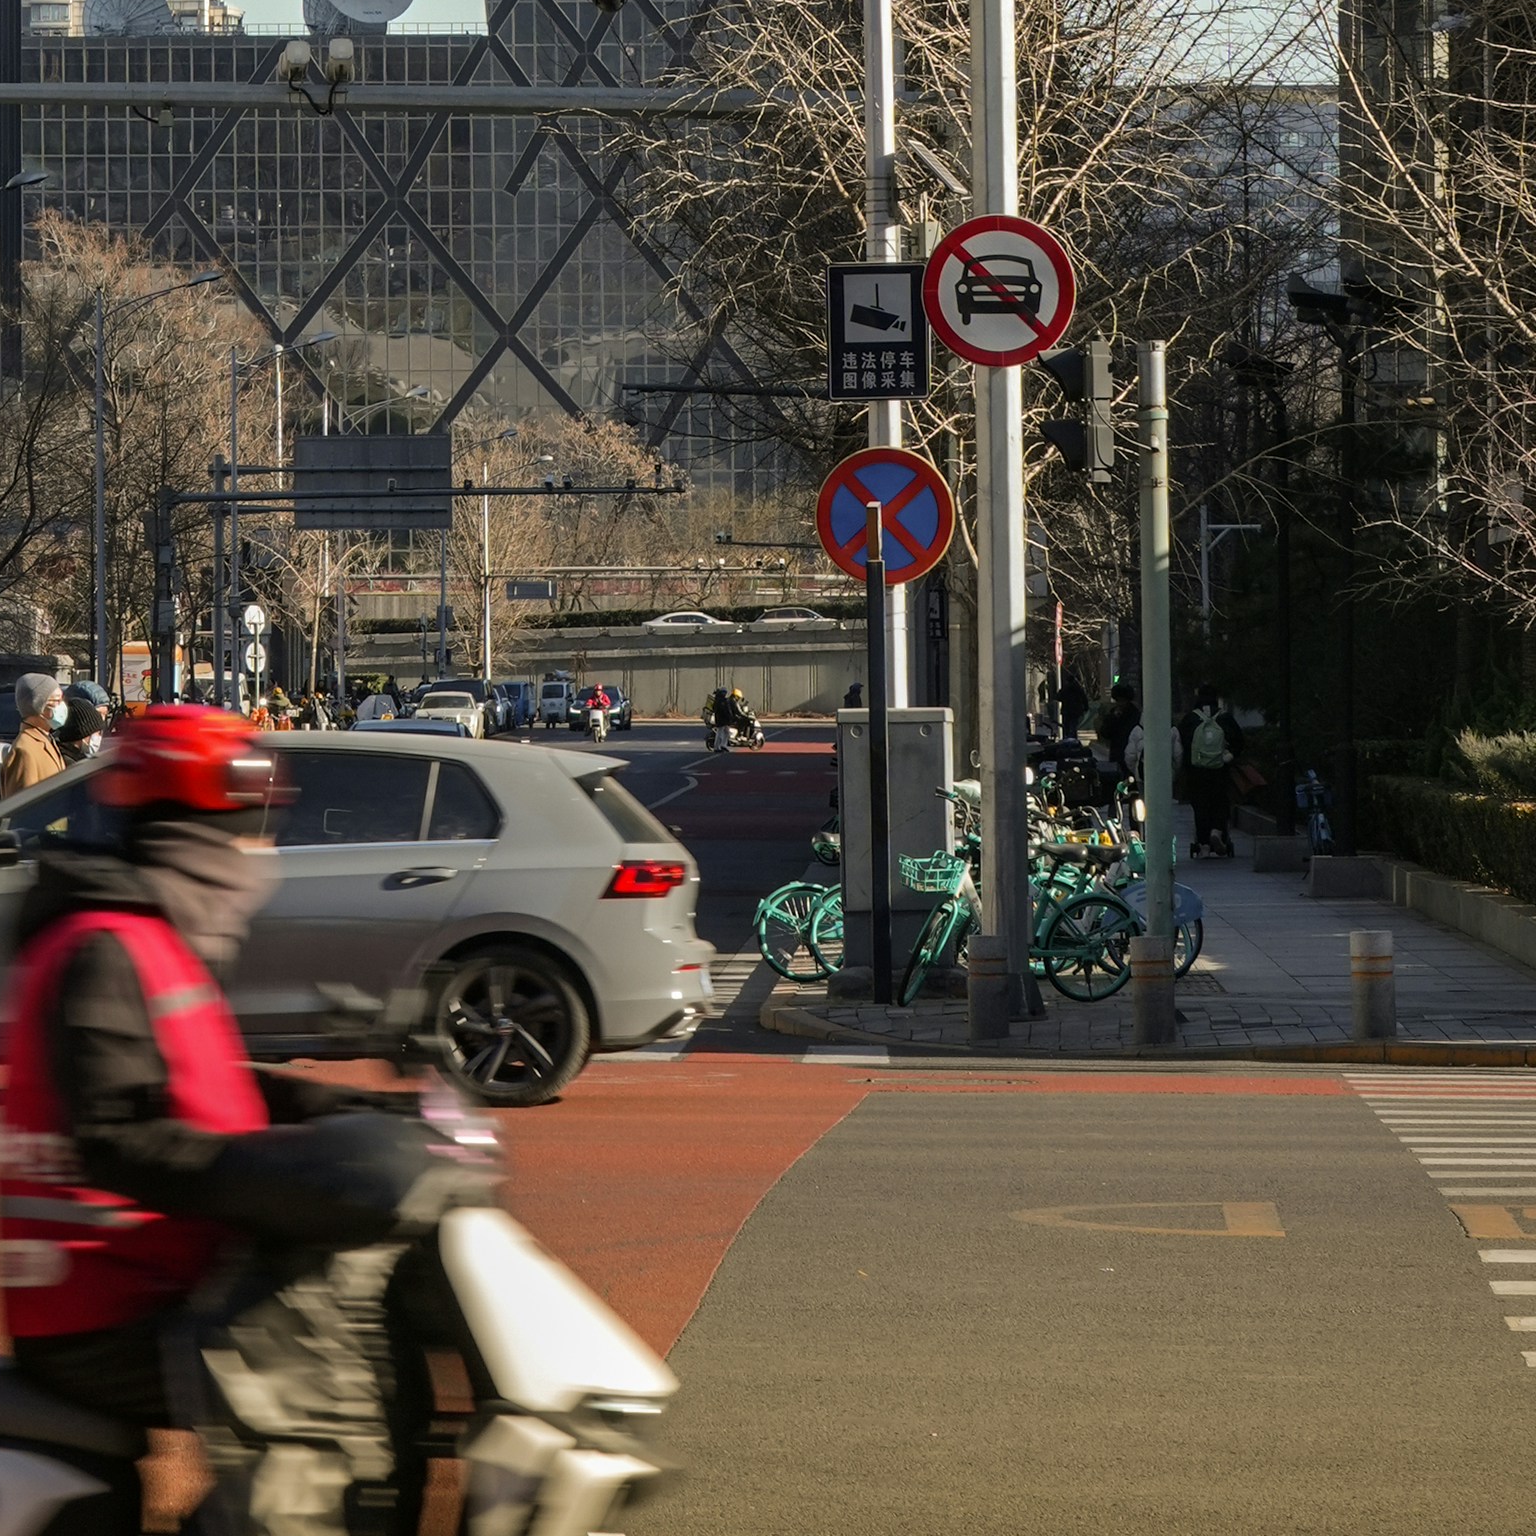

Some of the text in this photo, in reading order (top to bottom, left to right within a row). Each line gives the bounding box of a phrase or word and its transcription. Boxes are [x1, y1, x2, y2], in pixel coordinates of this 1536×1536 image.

[842, 350, 915, 370] 违法停车
[842, 370, 916, 390] 图像采集
